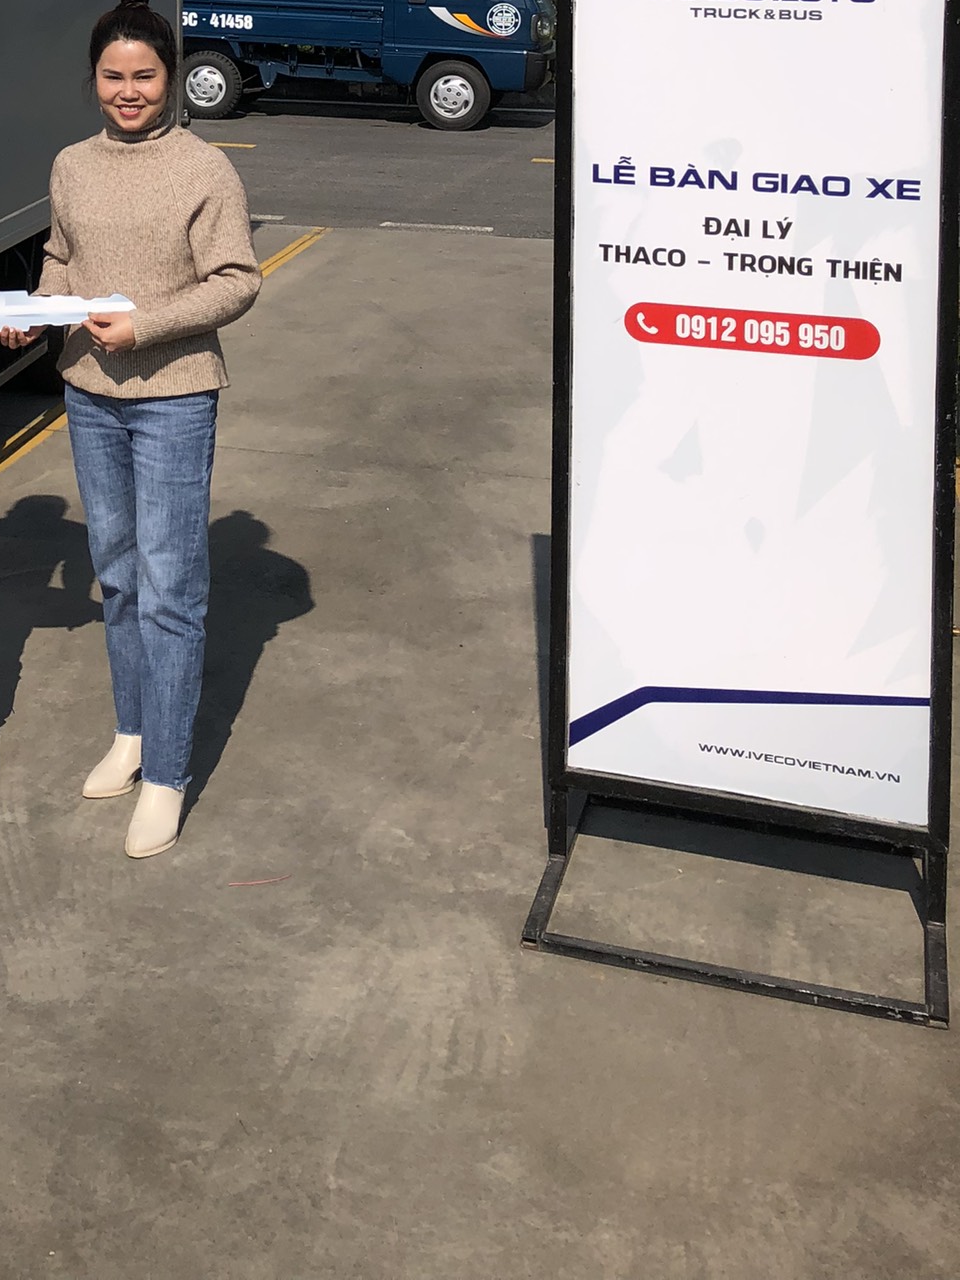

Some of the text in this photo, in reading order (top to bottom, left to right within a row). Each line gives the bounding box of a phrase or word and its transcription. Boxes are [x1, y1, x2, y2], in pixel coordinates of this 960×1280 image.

[181, 11, 199, 27] 5C
[209, 13, 254, 30] 41458
[592, 156, 921, 201] LỄ BÀN GIAO XE
[702, 216, 793, 241] ĐẠI LÝ
[598, 243, 686, 267] THACO
[723, 252, 813, 278] TRỌNG
[826, 257, 903, 285] THIỆN
[675, 313, 846, 352] 0912 095 950
[698, 743, 901, 783] WWW.IVECOVIETNAM.VN
